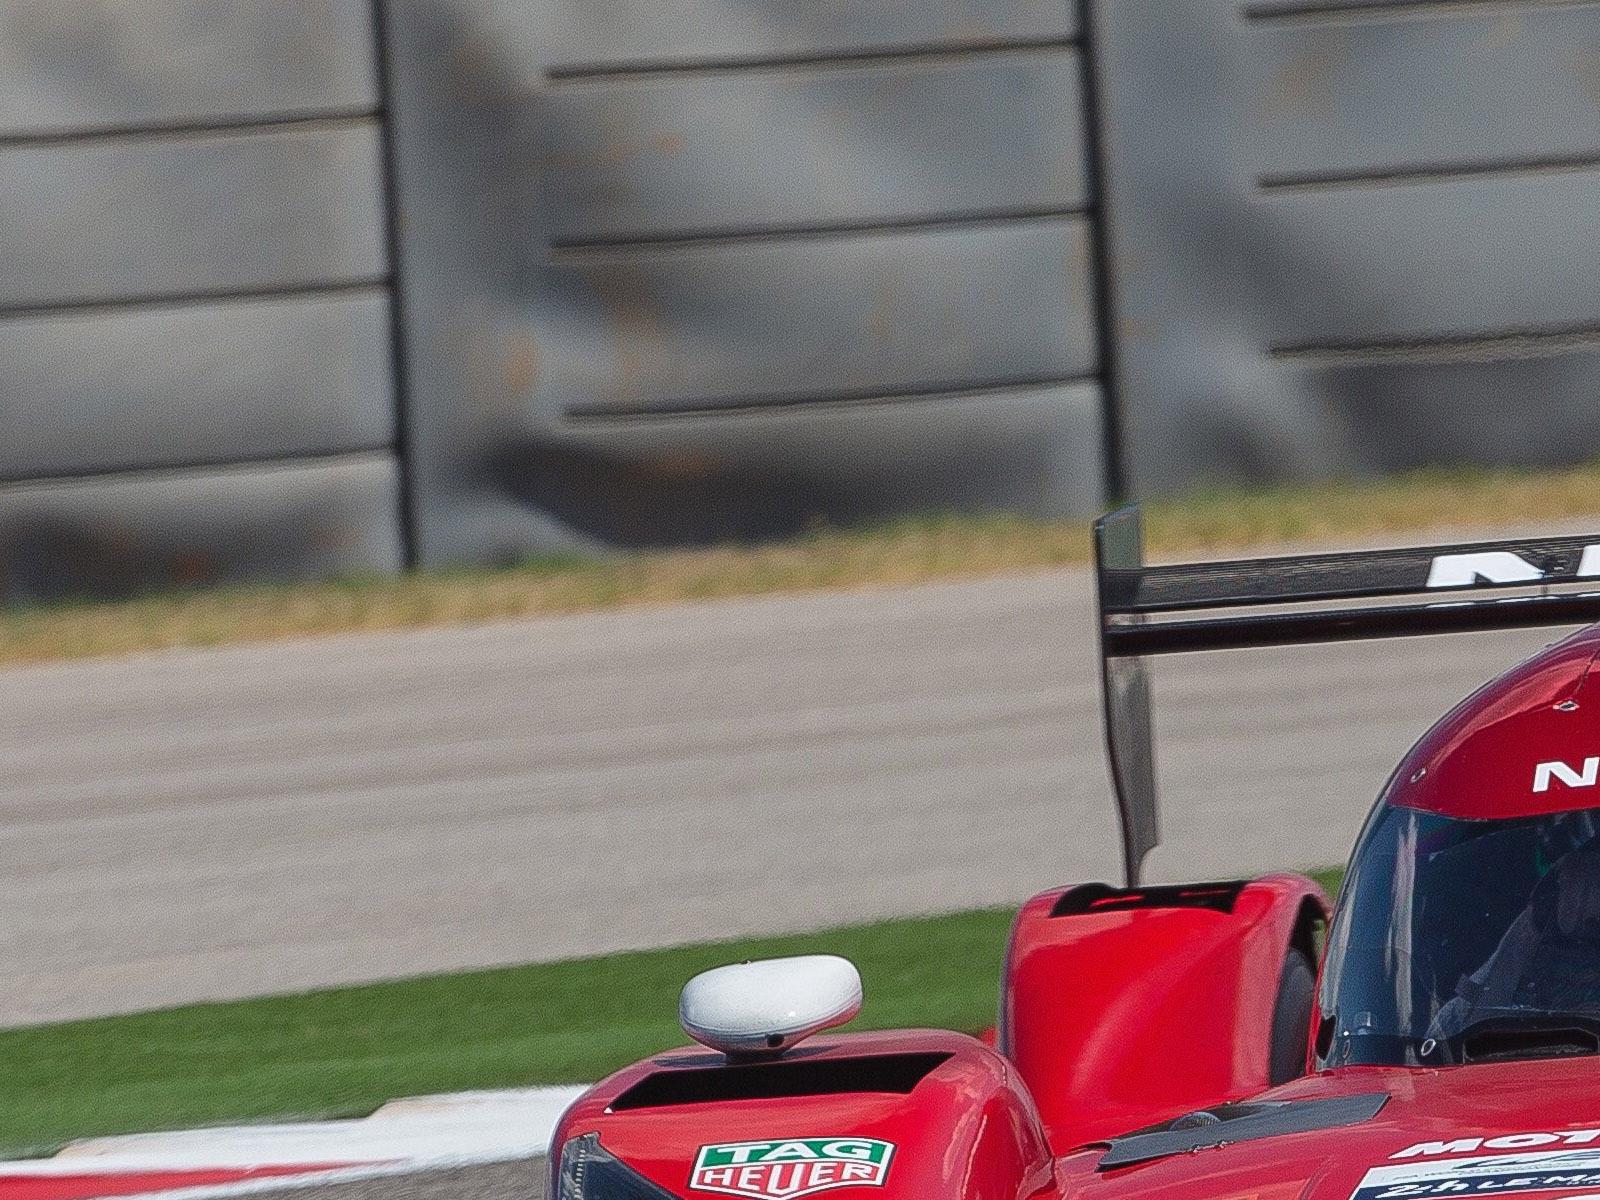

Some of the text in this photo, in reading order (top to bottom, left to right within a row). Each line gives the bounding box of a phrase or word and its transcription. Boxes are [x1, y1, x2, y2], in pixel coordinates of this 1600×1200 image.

[716, 1141, 873, 1162] TAG
[703, 1162, 878, 1198] HEUER
[1476, 1177, 1537, 1190] LE
